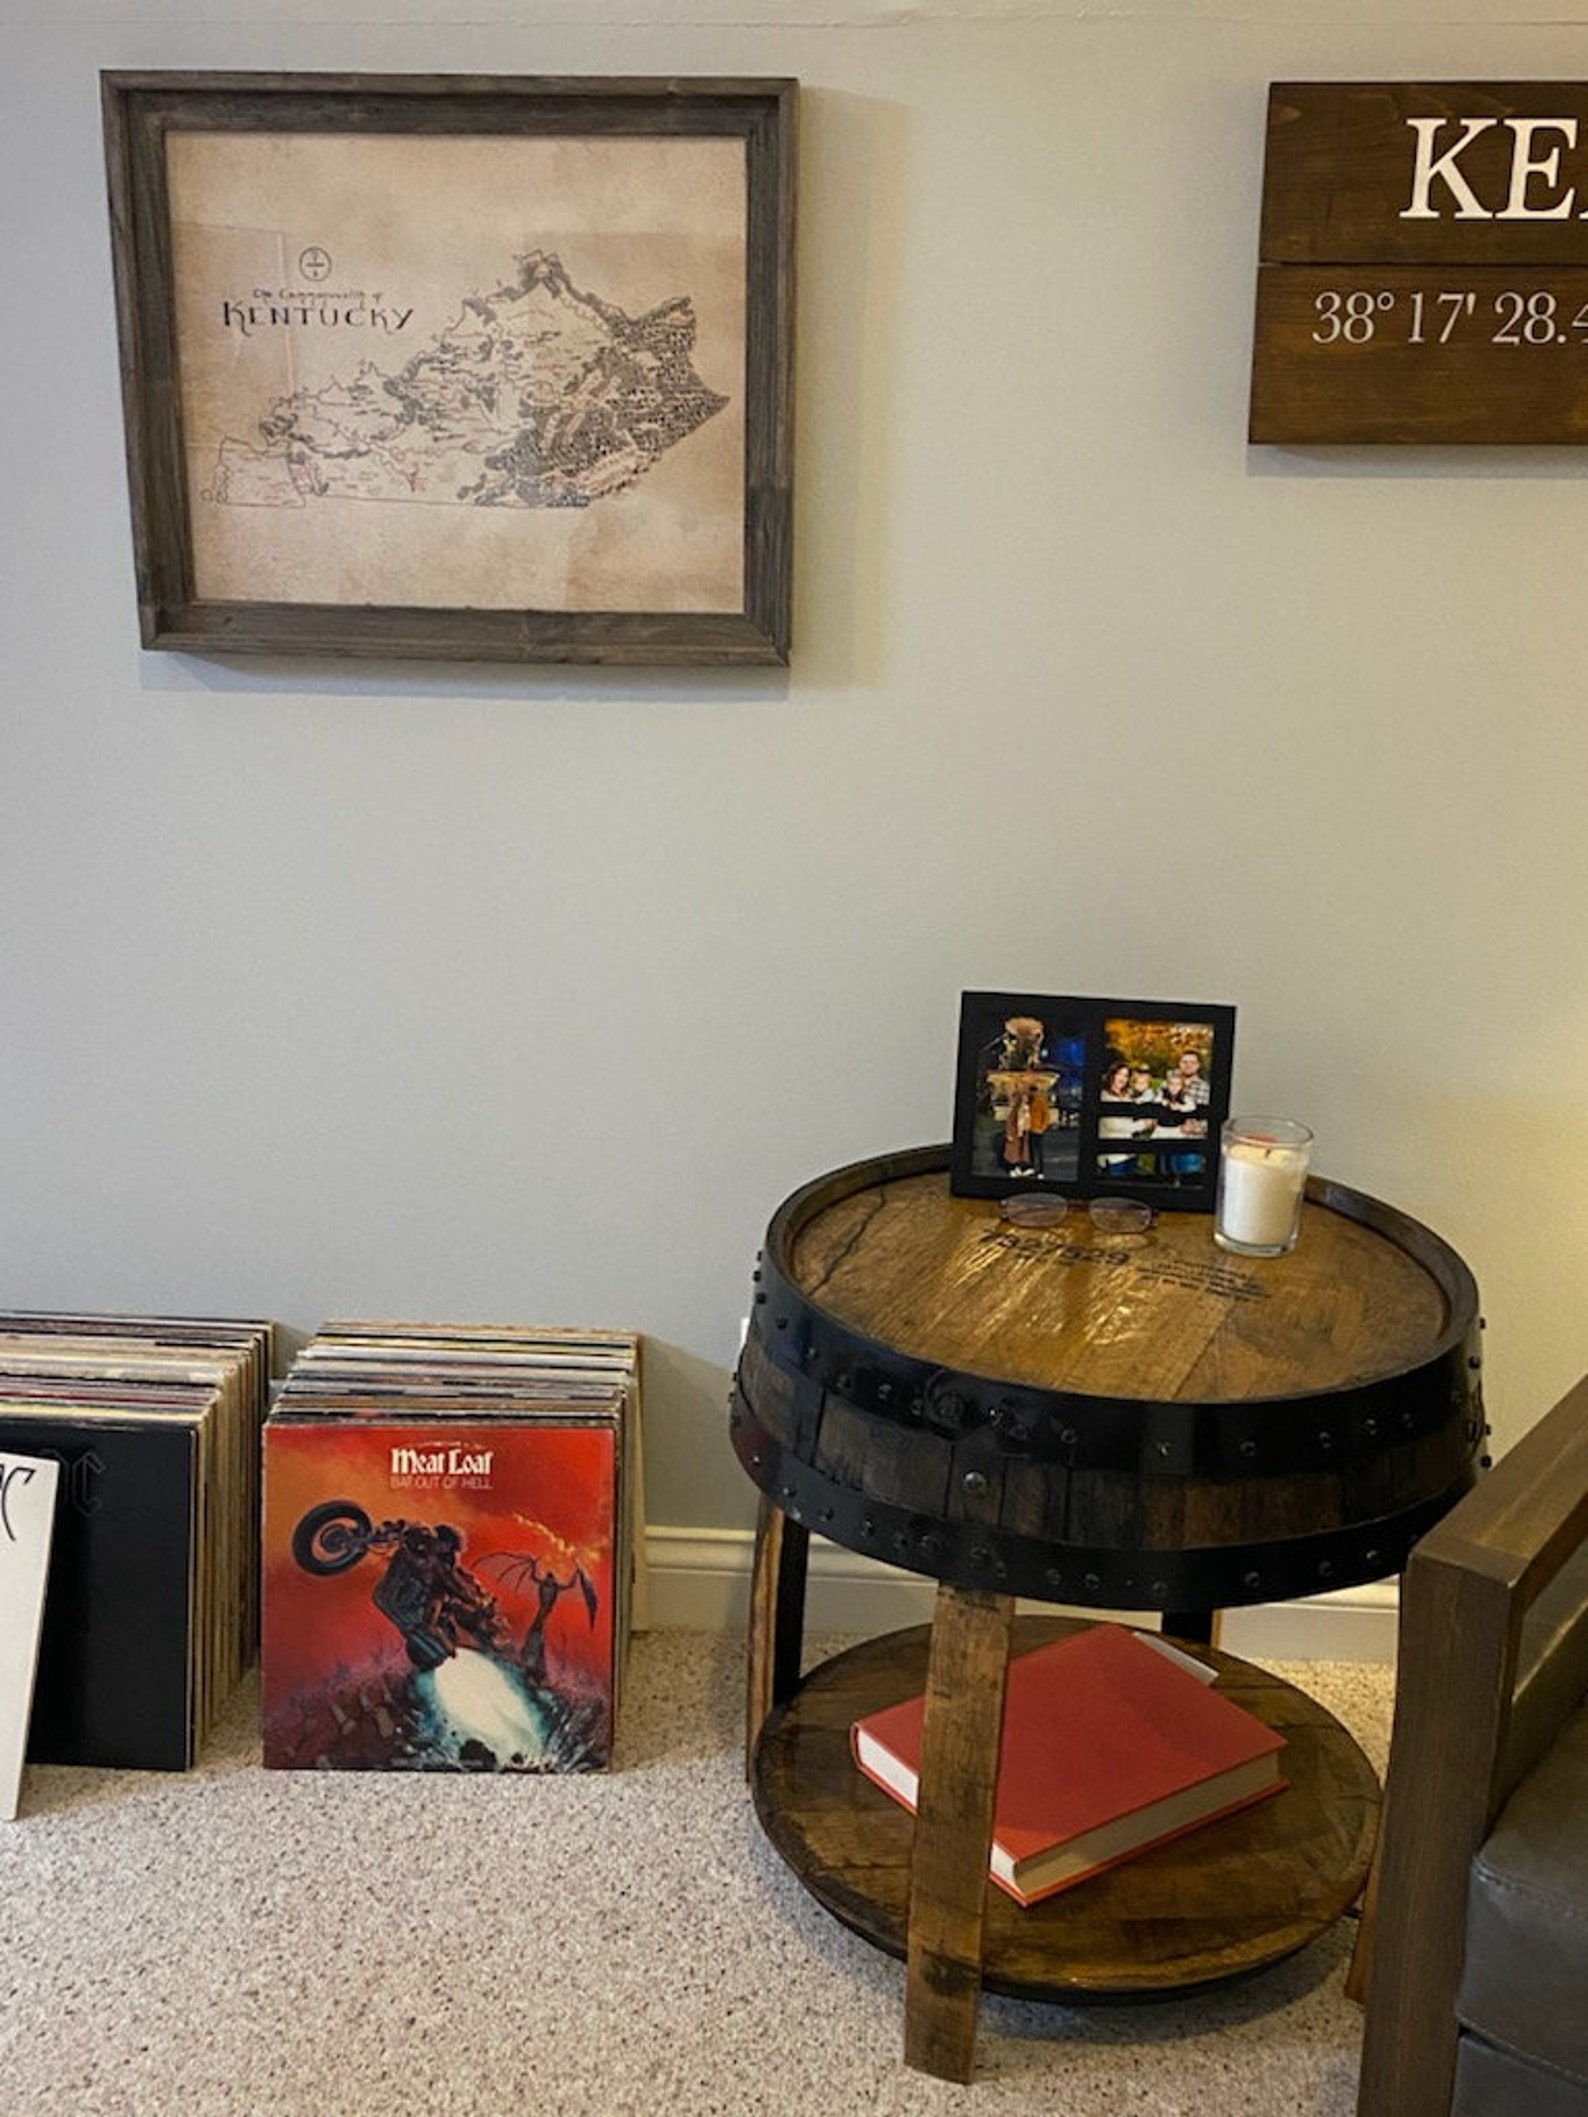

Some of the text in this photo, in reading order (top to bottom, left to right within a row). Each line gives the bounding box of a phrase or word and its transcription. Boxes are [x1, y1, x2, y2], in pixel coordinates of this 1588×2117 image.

[1399, 117, 1588, 220] KE
[223, 301, 414, 338] KENTUCKY
[391, 1448, 494, 1475] Meat Loaf
[461, 1476, 493, 1490] HELL
